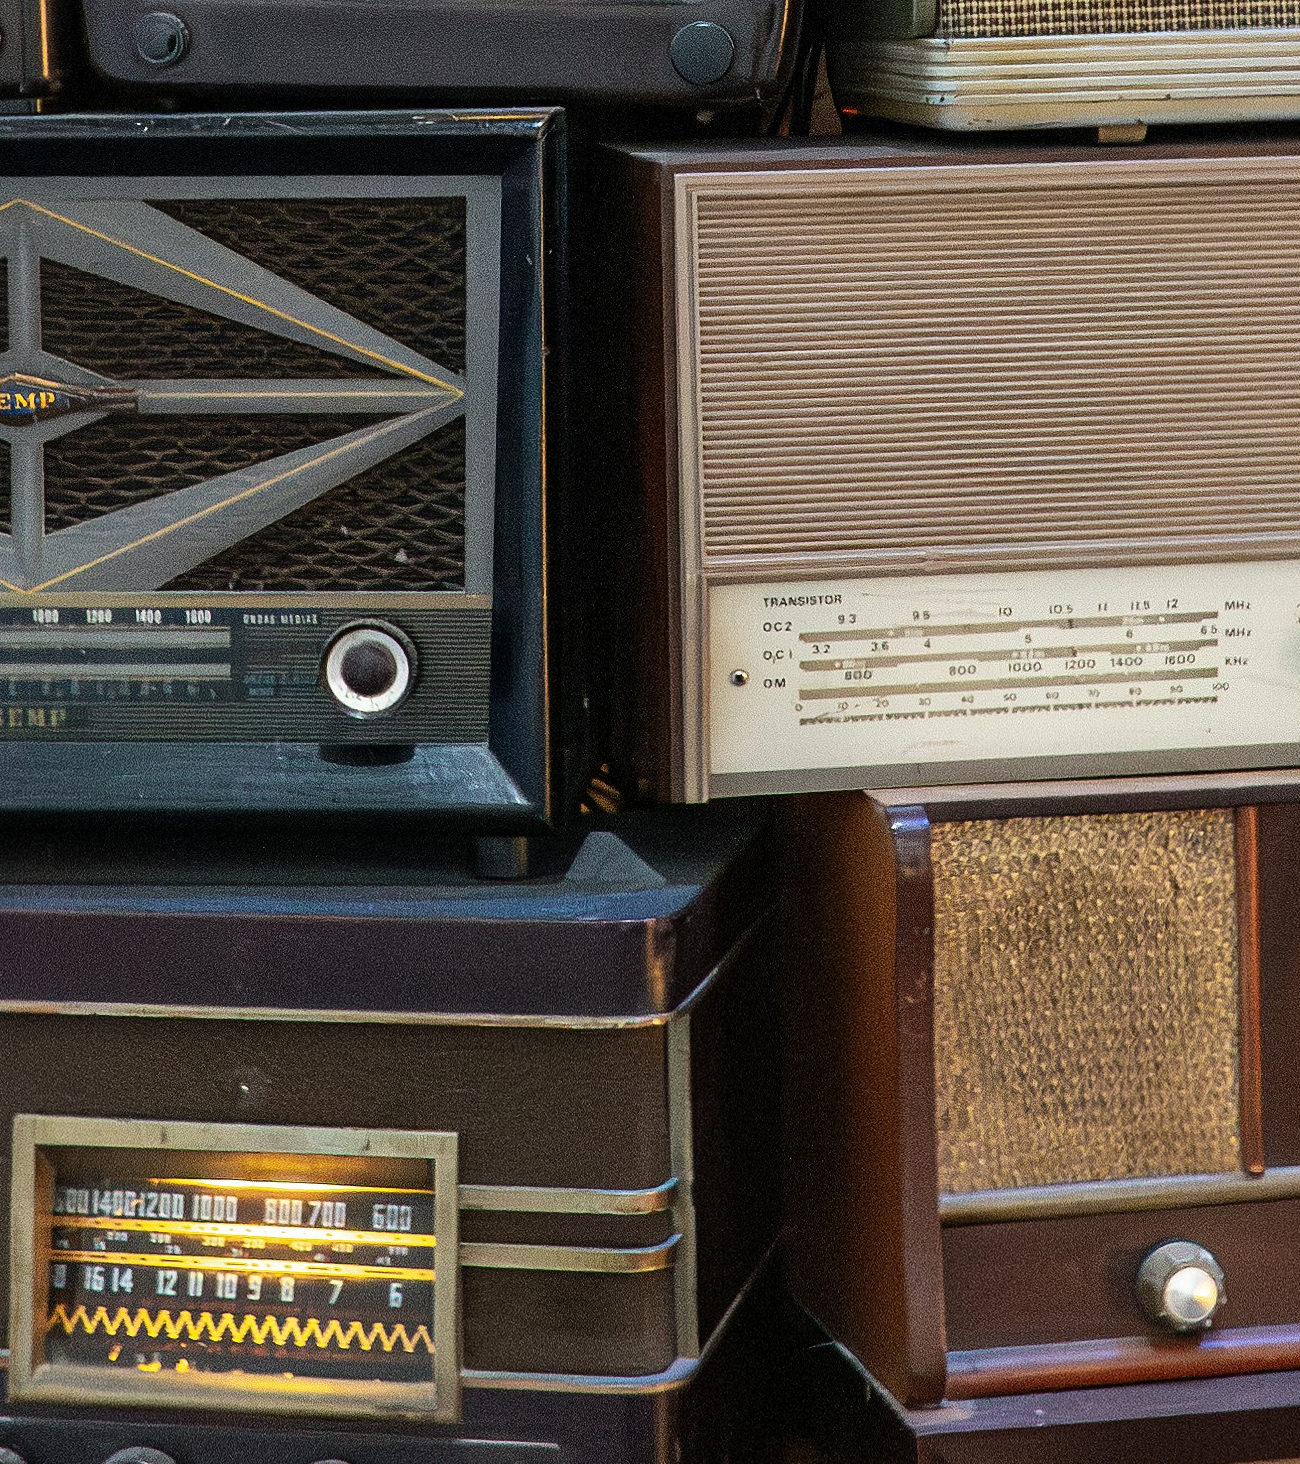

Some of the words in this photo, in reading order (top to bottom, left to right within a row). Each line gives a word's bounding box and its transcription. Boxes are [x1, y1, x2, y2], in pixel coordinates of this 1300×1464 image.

[135, 609, 162, 624] 1400
[763, 594, 842, 608] TRANSISTOR
[763, 621, 793, 632] OC2
[1166, 598, 1179, 609] 12
[923, 638, 931, 649] 4
[763, 677, 786, 689] OM
[948, 665, 976, 676] 800
[1007, 661, 1042, 673] 1000
[1064, 659, 1096, 670] 1200
[1110, 656, 1143, 667] 1400
[92, 1189, 137, 1216] 1400
[138, 1192, 184, 1219] 1200
[192, 1194, 238, 1222] 1000
[263, 1197, 303, 1226] 800
[307, 1200, 347, 1228] 700
[371, 1203, 413, 1232] 600
[83, 1266, 105, 1292] 16
[110, 1267, 134, 1293] 14
[155, 1269, 177, 1296] 12
[187, 1271, 203, 1298] 11
[215, 1272, 237, 1300] 10
[246, 1274, 262, 1301] 9
[279, 1276, 296, 1302] 8
[328, 1279, 344, 1305] 7
[388, 1282, 404, 1309] 6
